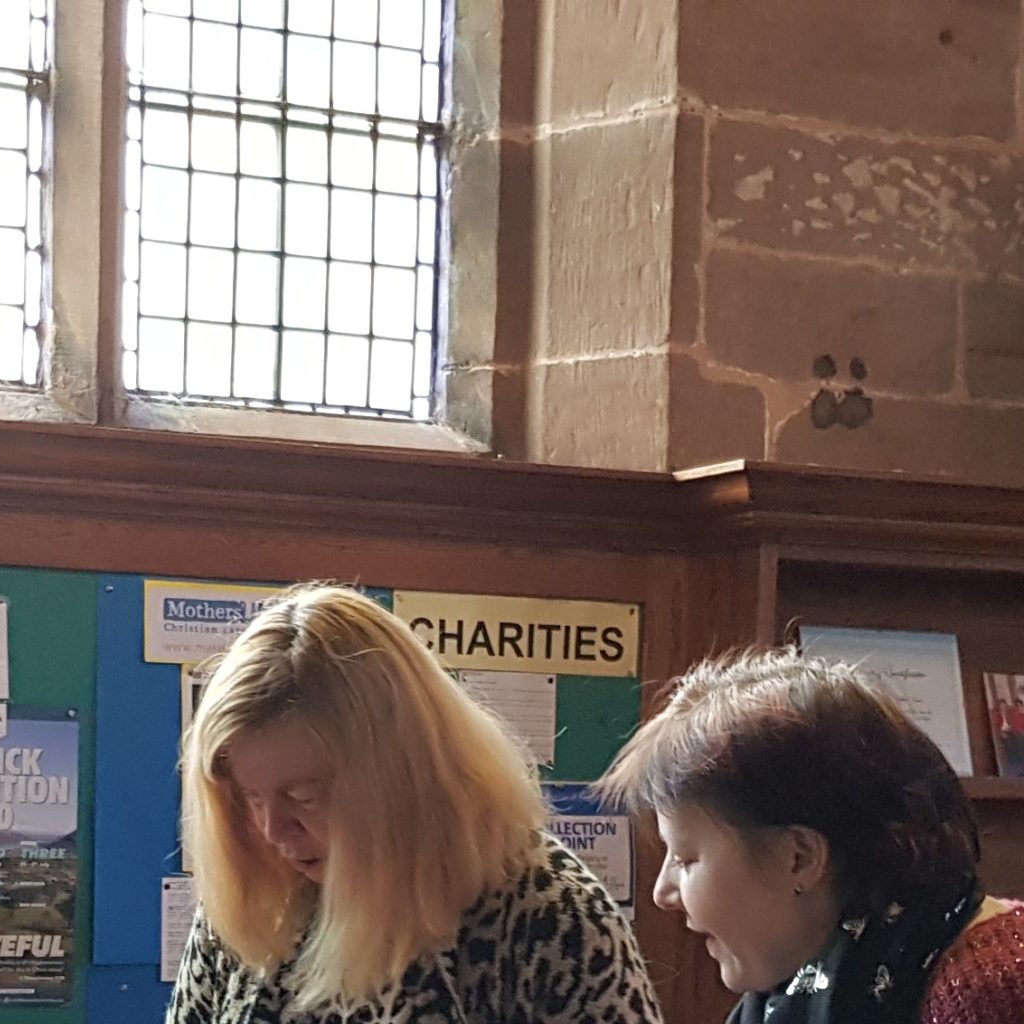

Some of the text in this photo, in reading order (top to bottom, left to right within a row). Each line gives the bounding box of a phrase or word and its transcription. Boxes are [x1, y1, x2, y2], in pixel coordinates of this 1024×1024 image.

[163, 622, 218, 633] Christian
[410, 616, 624, 662] CHARITIES
[547, 821, 617, 836] LLECTION
[21, 847, 67, 860] THREE
